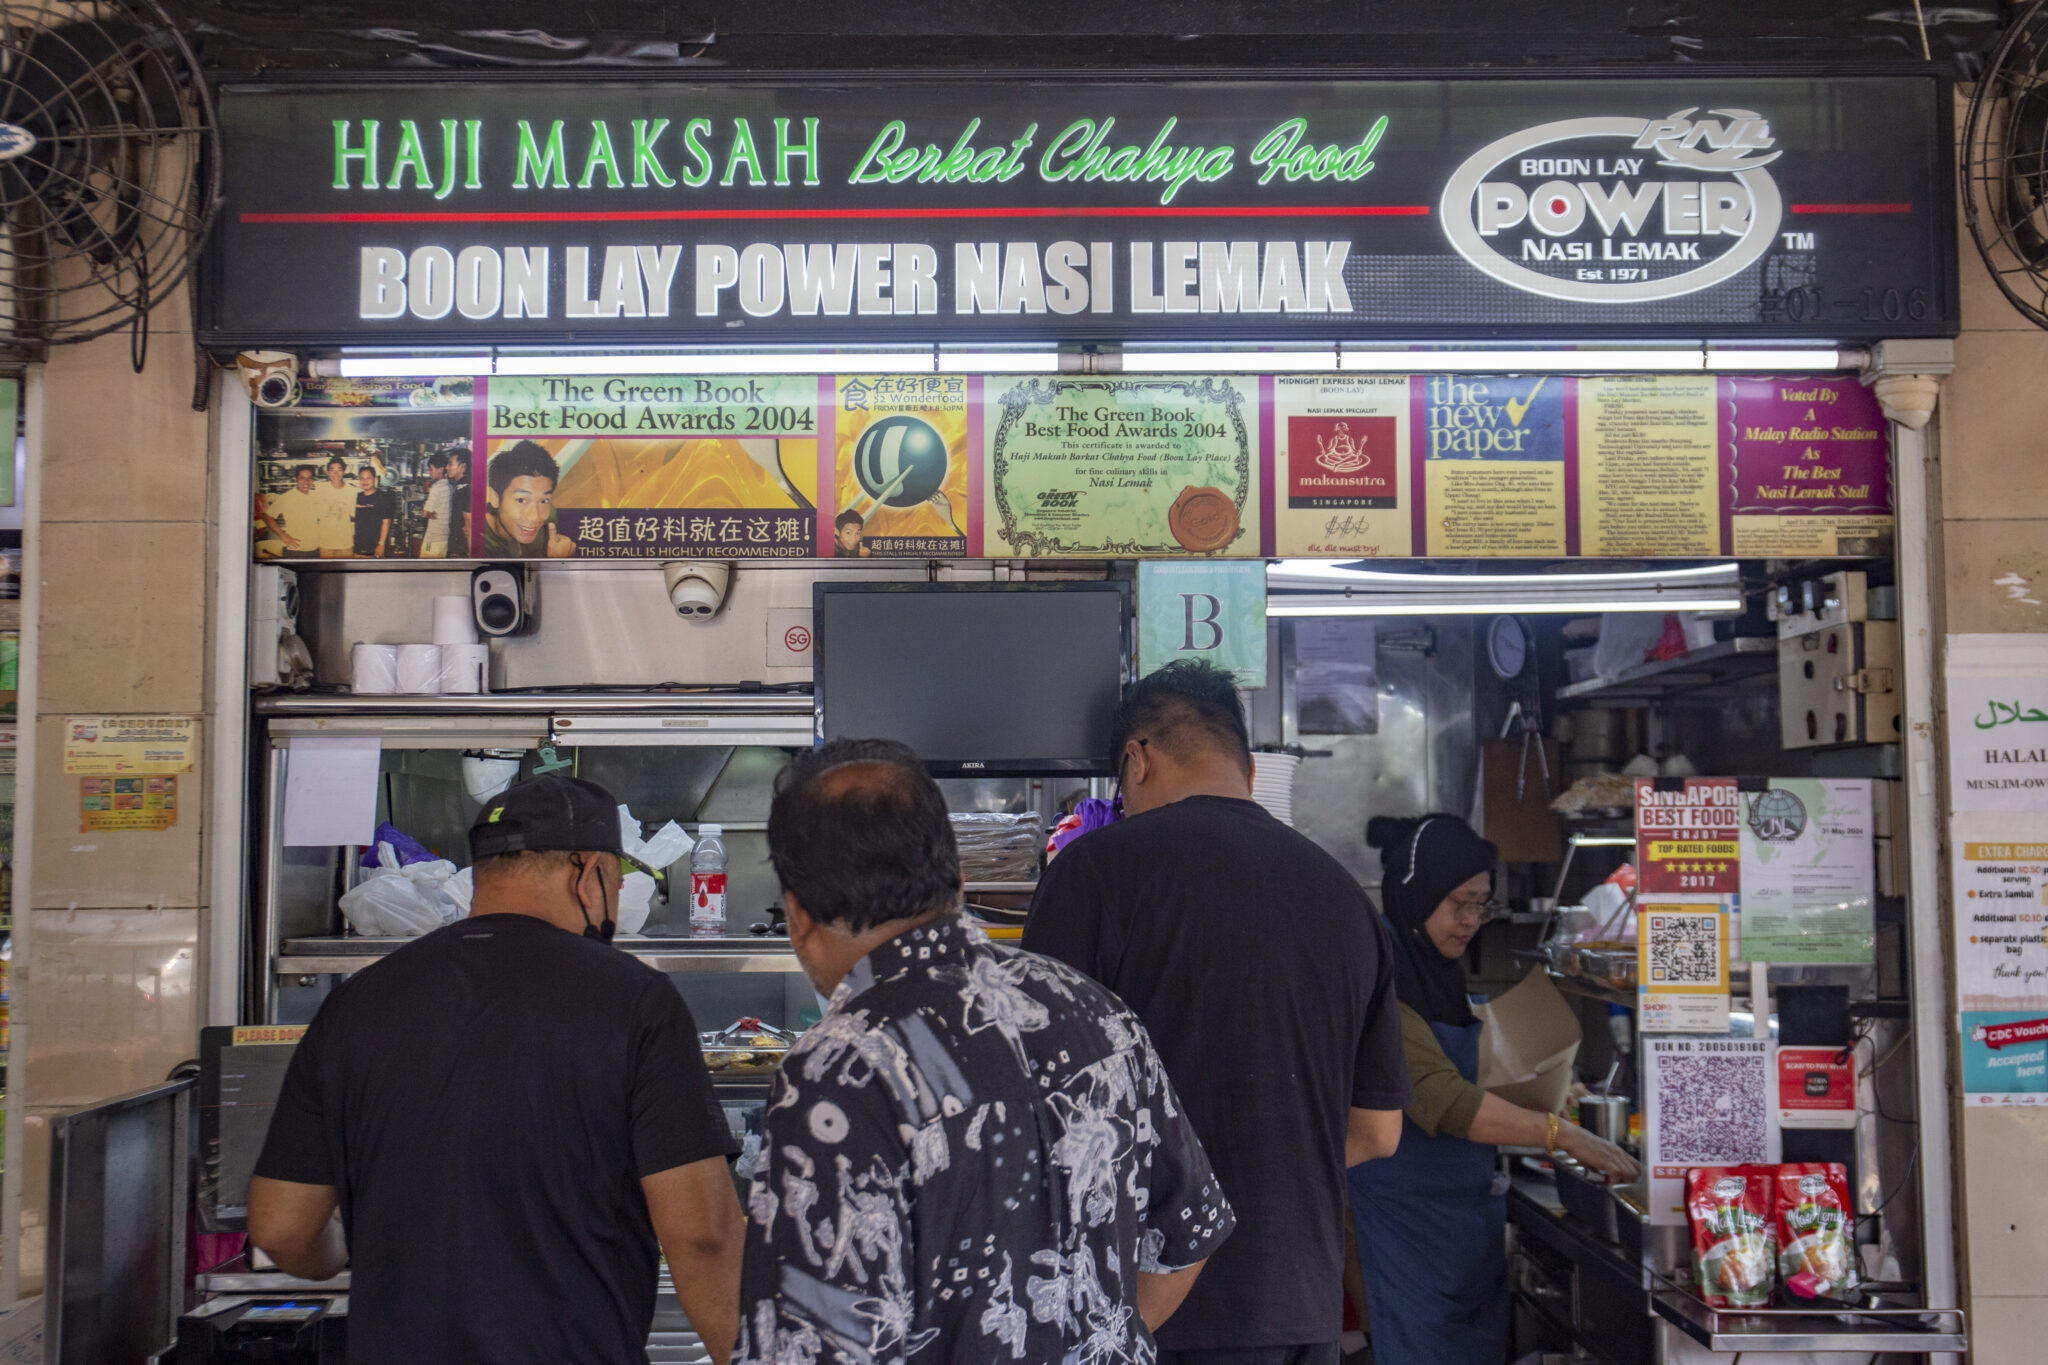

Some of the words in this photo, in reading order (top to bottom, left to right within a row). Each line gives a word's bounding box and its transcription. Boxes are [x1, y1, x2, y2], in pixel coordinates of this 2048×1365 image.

[1632, 119, 1776, 149] PNL
[333, 118, 482, 199] HAJI
[512, 117, 820, 190] MAKSAH
[848, 116, 1039, 185] Berkat
[1040, 115, 1235, 205] Chahya
[1249, 114, 1389, 186] Food
[1520, 158, 1591, 176] BOON
[1597, 158, 1644, 175] LAY
[1478, 180, 1754, 236] POWER
[1782, 231, 1815, 250] TM
[359, 245, 549, 319] BOON
[565, 244, 682, 318] LAY
[695, 242, 938, 317] POWER
[955, 240, 1114, 315] NASI
[1130, 240, 1354, 314] LEMAK
[1609, 268, 1649, 281] 1971
[872, 376, 965, 394] 在好便宜
[1278, 377, 1319, 385] MIDNIGHT
[1322, 377, 1355, 385] EXPRESS
[1357, 377, 1376, 385] NASI
[1378, 377, 1406, 385] LEMAK
[542, 378, 595, 402] The
[603, 378, 685, 403] Green
[693, 379, 765, 404] Book
[839, 377, 873, 412] 食
[1429, 374, 1490, 406] the
[1781, 387, 1819, 403] Voted
[1819, 387, 1839, 405] By
[890, 393, 965, 404] Wonderfood
[493, 404, 551, 429] Best
[558, 404, 628, 430] Food
[635, 405, 736, 431] Awards
[744, 406, 814, 431] 2004
[1055, 406, 1089, 421] The
[1094, 406, 1145, 422] Green
[1151, 407, 1196, 422] Book
[1429, 405, 1505, 429] new
[1803, 407, 1816, 421] A
[1025, 422, 1062, 437] Best
[1066, 422, 1110, 437] Food
[1115, 422, 1178, 438] Awards
[1183, 423, 1227, 438] 2004
[1744, 427, 1787, 444] Malay
[1788, 427, 1830, 441] Radio
[1831, 426, 1879, 441] Station
[1061, 441, 1080, 449] This
[1081, 441, 1123, 449] certificate
[1429, 428, 1532, 460] paper
[1010, 452, 1031, 463] Haji
[1186, 453, 1203, 463] Lay
[1801, 446, 1821, 460] As
[1075, 467, 1087, 475] for
[1089, 467, 1104, 475] fine
[1783, 465, 1810, 480] The
[1811, 465, 1842, 480] Best
[1089, 477, 1115, 487] Nasi
[1117, 477, 1153, 488] Lemak
[1299, 473, 1387, 487] makansutra
[1756, 484, 1788, 499] Nasi
[1789, 484, 1836, 499] Lemak
[1837, 484, 1870, 499] Stall
[1041, 499, 1079, 508] BOOK
[578, 546, 606, 557] THIS
[608, 546, 643, 557] STALL
[645, 546, 656, 557] IS
[658, 546, 704, 557] HIGHLY
[708, 546, 810, 557] RECOMMENDED!
[1324, 543, 1338, 552] die
[1177, 591, 1225, 652] B
[787, 632, 809, 645] SG
[961, 761, 986, 769] AKIRA
[1966, 778, 2048, 790] MUSLIM-OW
[1643, 808, 1687, 826] BEST
[1672, 829, 1719, 840] ENJOY
[1657, 844, 1674, 854] TOP
[1676, 844, 1705, 854] RATED
[1706, 844, 1735, 854] FOODS
[1978, 846, 2012, 858] EXTRA
[1681, 875, 1716, 887] 2017
[2002, 876, 2031, 886] serving
[1978, 890, 2003, 898] Extra
[2004, 889, 2034, 898] Sambal
[1973, 914, 2017, 922] Additional
[1980, 935, 2018, 946] separate
[2006, 945, 2023, 956] bag
[1993, 962, 2022, 979] thank
[236, 1030, 277, 1042] PLEASE
[1987, 1028, 2013, 1041] CDC
[1987, 1049, 2045, 1068] Accepted
[2016, 1065, 2046, 1078] here
